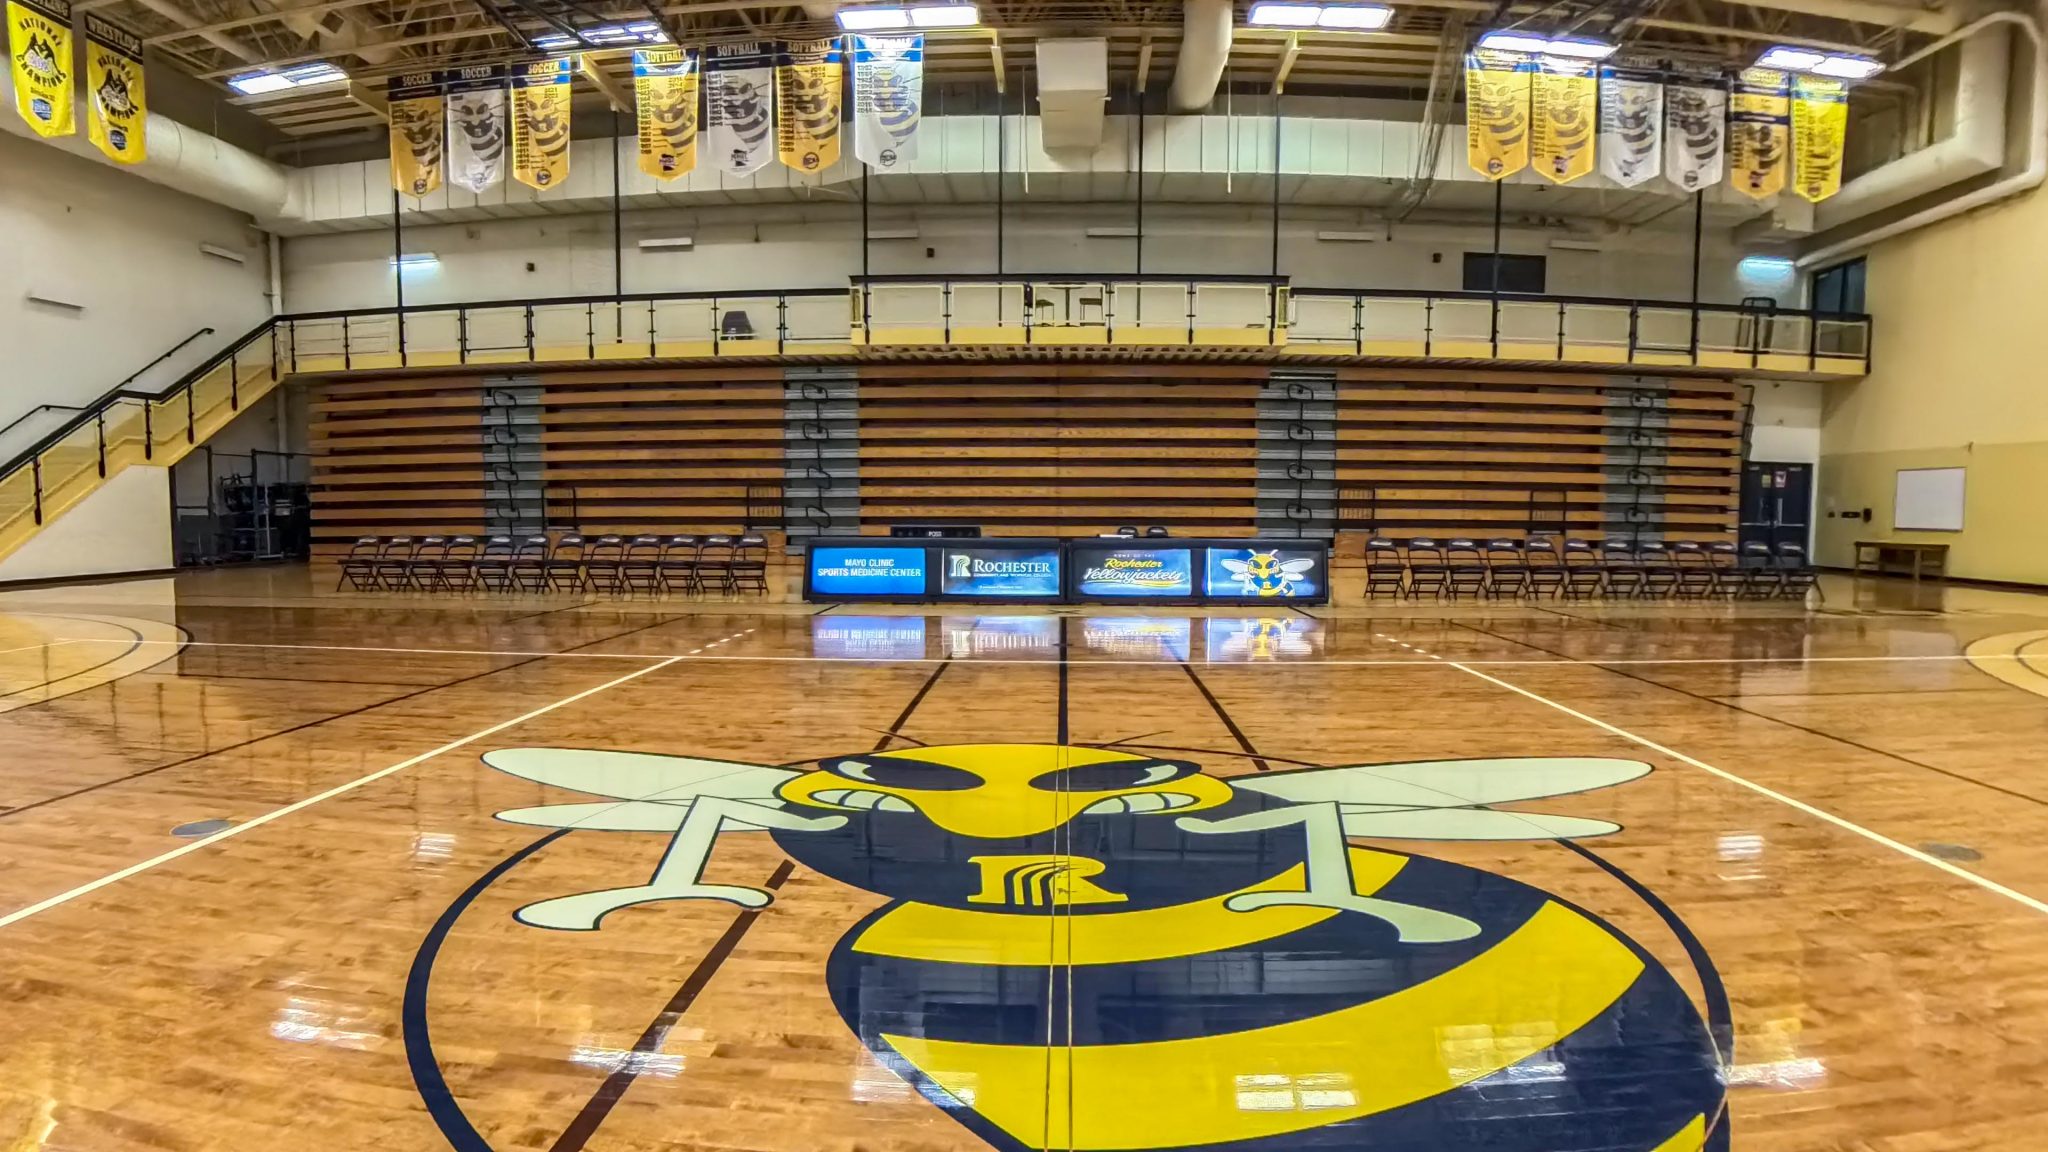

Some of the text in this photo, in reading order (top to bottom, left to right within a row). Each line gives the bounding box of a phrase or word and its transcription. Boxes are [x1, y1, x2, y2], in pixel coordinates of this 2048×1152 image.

[19, 17, 62, 47] NATIONAL
[87, 17, 141, 53] WRESTLING
[717, 42, 761, 57] SOFTBALL
[787, 40, 832, 53] SOFTBALL
[645, 48, 688, 62] SOFTBALL
[15, 55, 67, 88] CHAMPIONS
[461, 66, 492, 79] SOCCER
[527, 61, 560, 74] SOCCER
[402, 73, 433, 87] SOCCER
[844, 559, 895, 567] MAYO CLINIC
[974, 559, 1051, 573] ROCHESTER
[1104, 558, 1163, 569] Rochester
[817, 568, 922, 577] SPORTS MEDICINE CENTER
[1083, 567, 1184, 584] Yellowjackets
